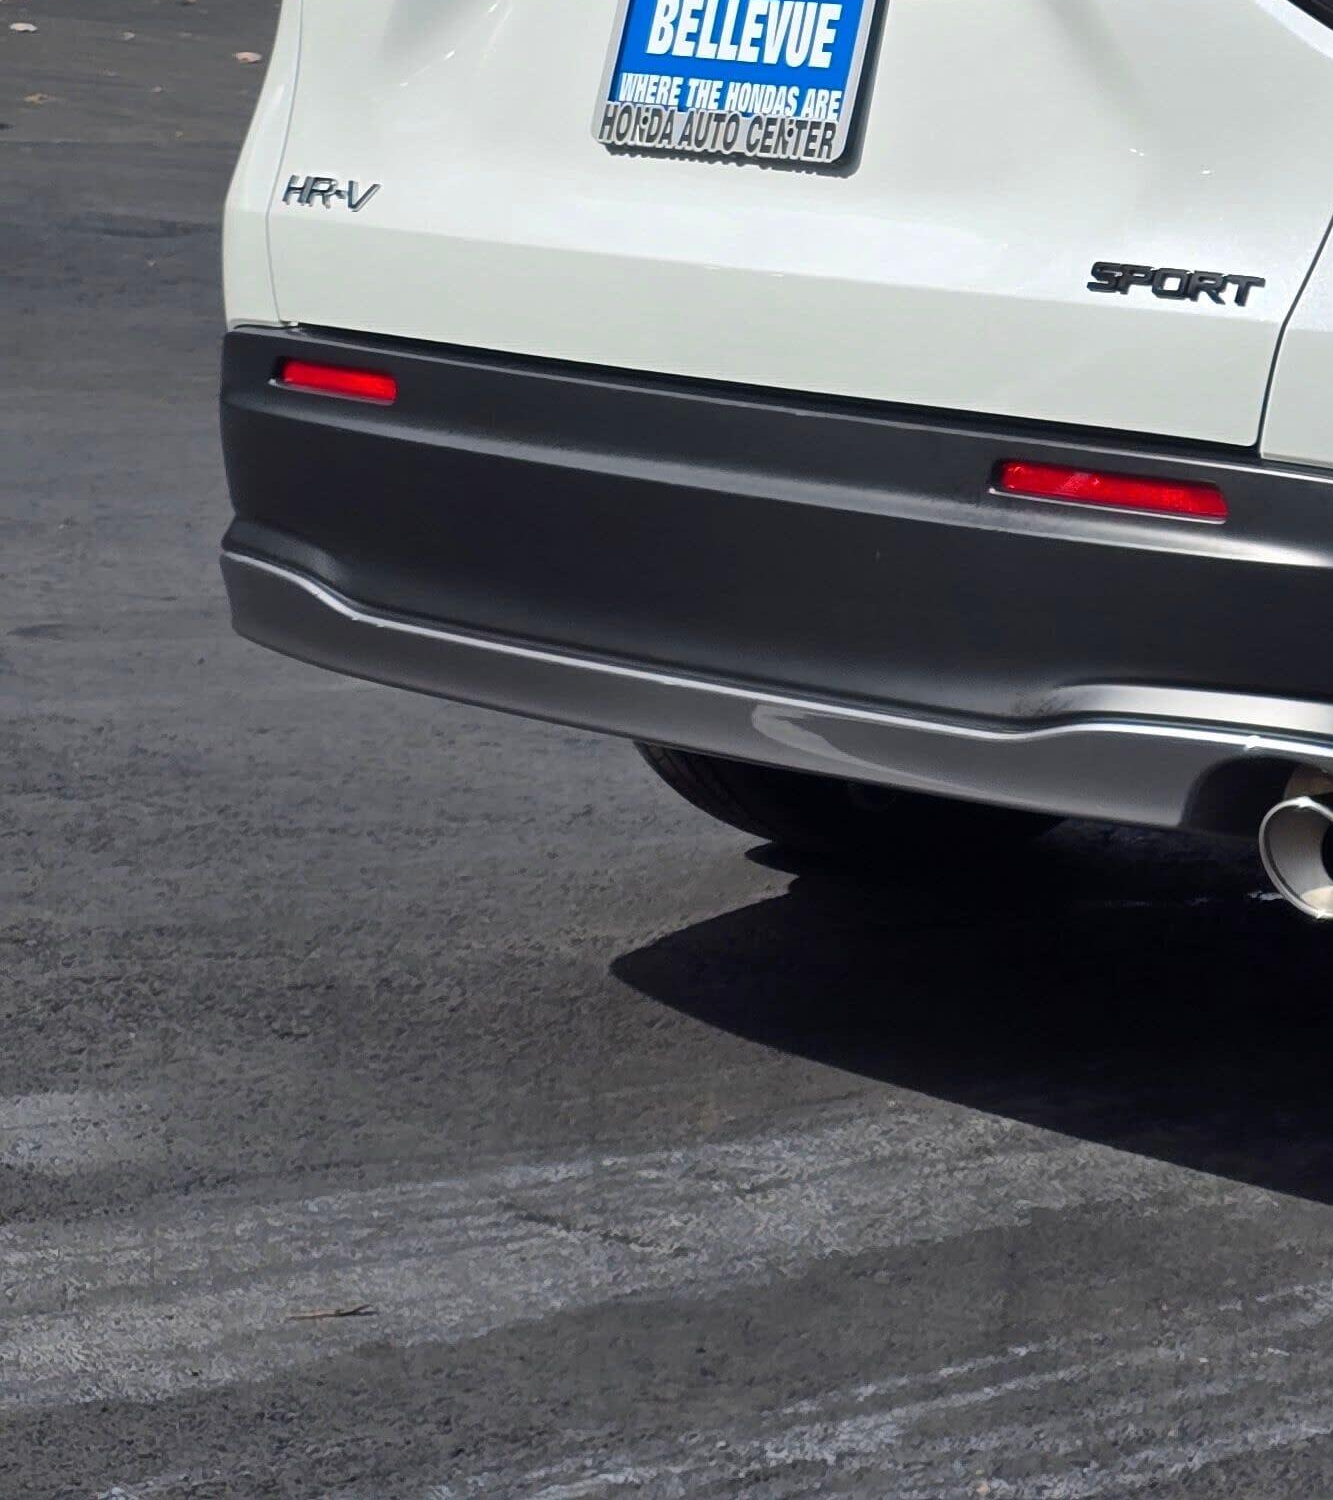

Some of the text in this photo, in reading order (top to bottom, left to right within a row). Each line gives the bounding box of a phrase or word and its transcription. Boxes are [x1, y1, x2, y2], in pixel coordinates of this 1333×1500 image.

[618, 72, 842, 121] WHERE THE HONDAS ARE
[599, 104, 837, 159] HONDA AUTO CENTER
[282, 175, 381, 212] HR-V
[1087, 261, 1266, 306] SPORT
